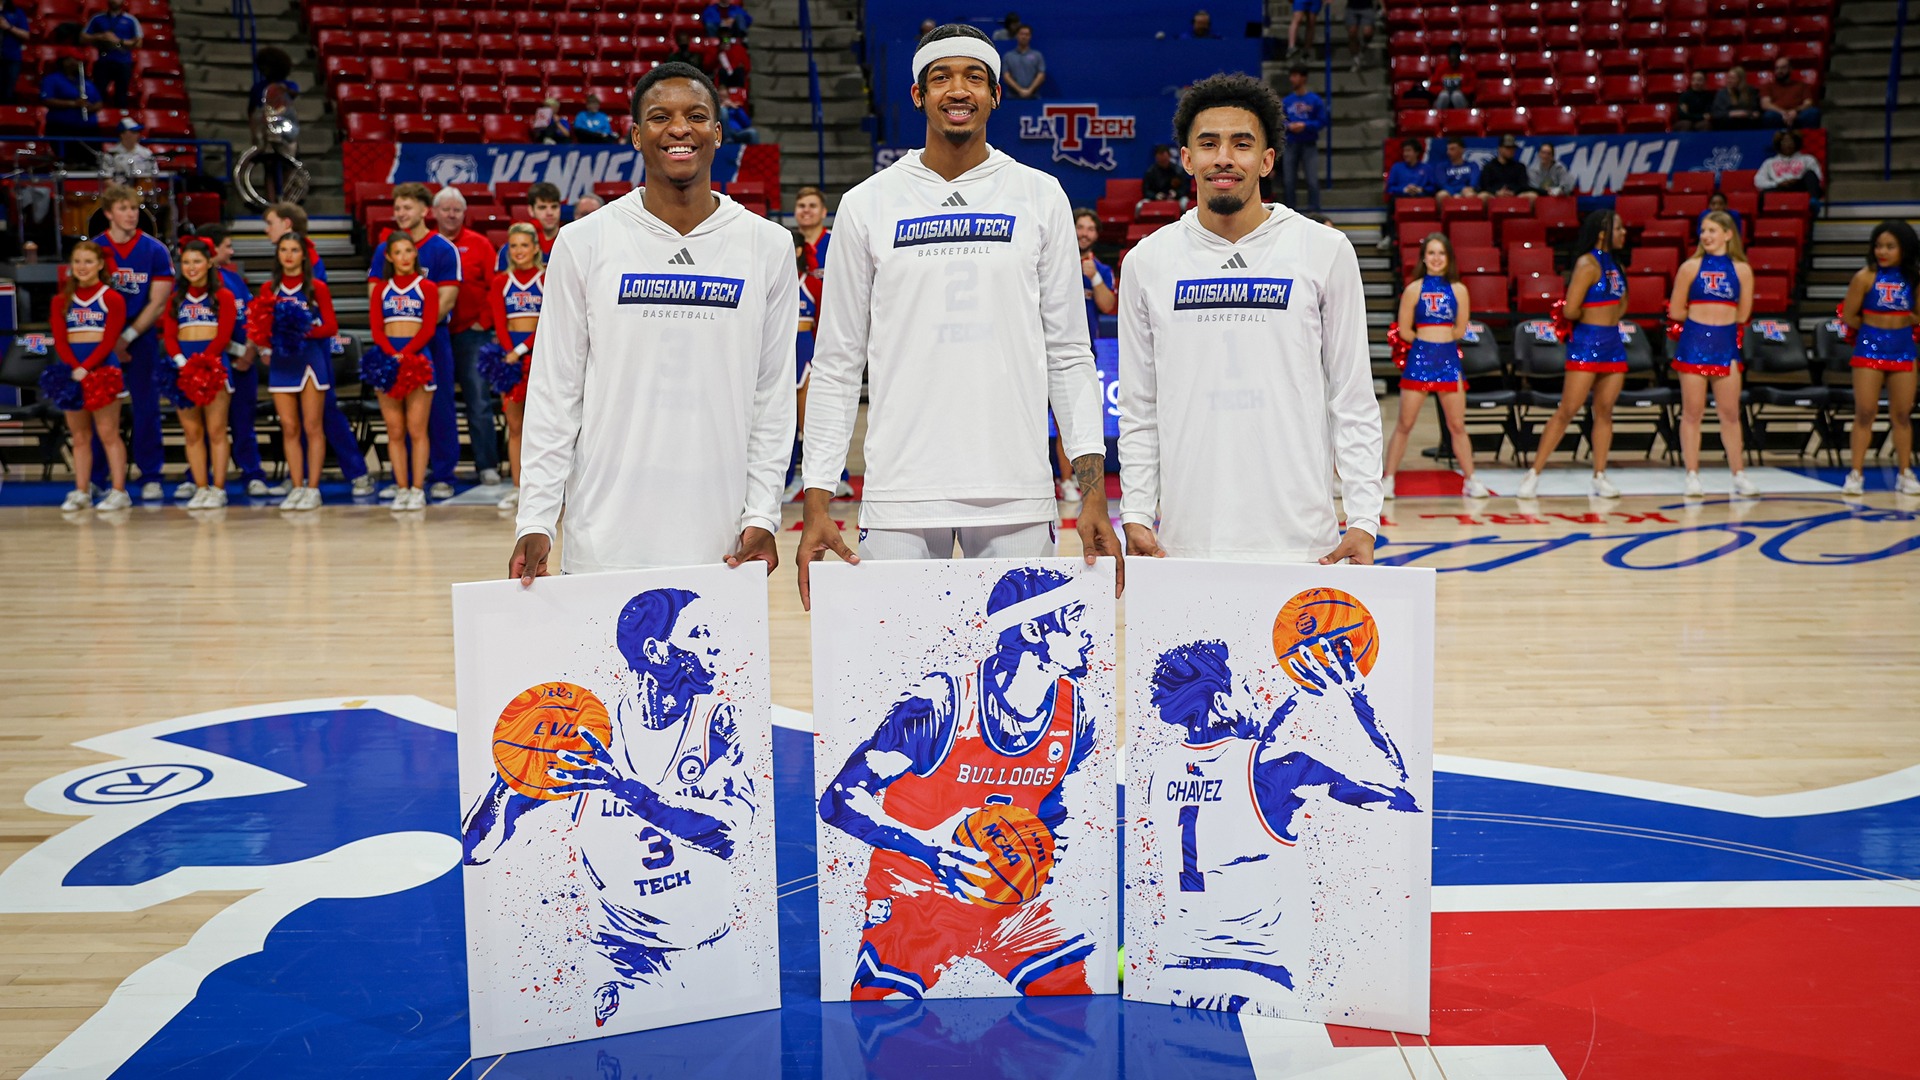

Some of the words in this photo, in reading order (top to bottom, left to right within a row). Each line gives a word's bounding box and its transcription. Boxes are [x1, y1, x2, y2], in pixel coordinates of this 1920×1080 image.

[1020, 116, 1056, 139] LA
[1043, 103, 1136, 151] TECH
[897, 218, 971, 242] LOUISIANA
[975, 218, 1010, 237] TECH
[917, 246, 991, 258] BASKETBALL
[621, 278, 697, 300] LOUISIANA
[700, 281, 739, 303] TECH
[1177, 283, 1249, 304] LOUISIANA
[1252, 283, 1288, 304] TECH
[642, 309, 716, 321] BASKETBALL
[1197, 313, 1267, 323] BASKETBALL
[1418, 511, 1680, 526] KARL
[956, 763, 1056, 786] BULLDOGS
[1166, 779, 1223, 802] CHAVEZ
[639, 826, 675, 871] 3
[1177, 805, 1206, 893] 1
[633, 869, 692, 897] TECH
